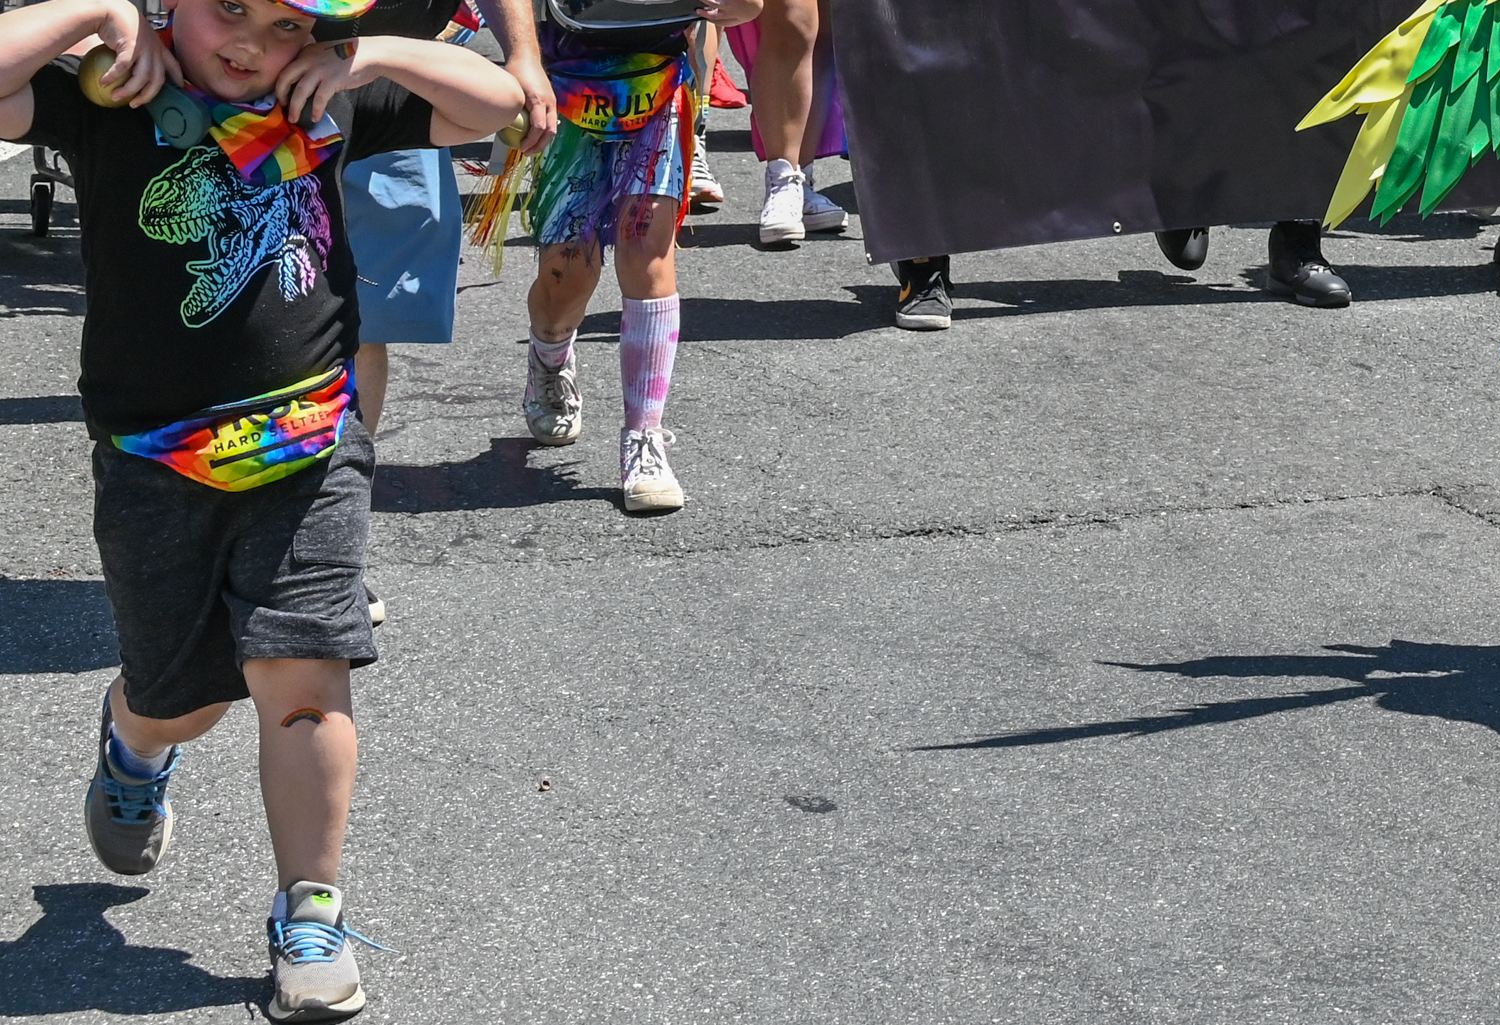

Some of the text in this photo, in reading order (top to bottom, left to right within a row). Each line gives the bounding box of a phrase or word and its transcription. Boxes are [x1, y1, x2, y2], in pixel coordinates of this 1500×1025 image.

[582, 90, 658, 117] TRULY
[581, 116, 608, 128] HARD
[214, 431, 262, 454] HARD
